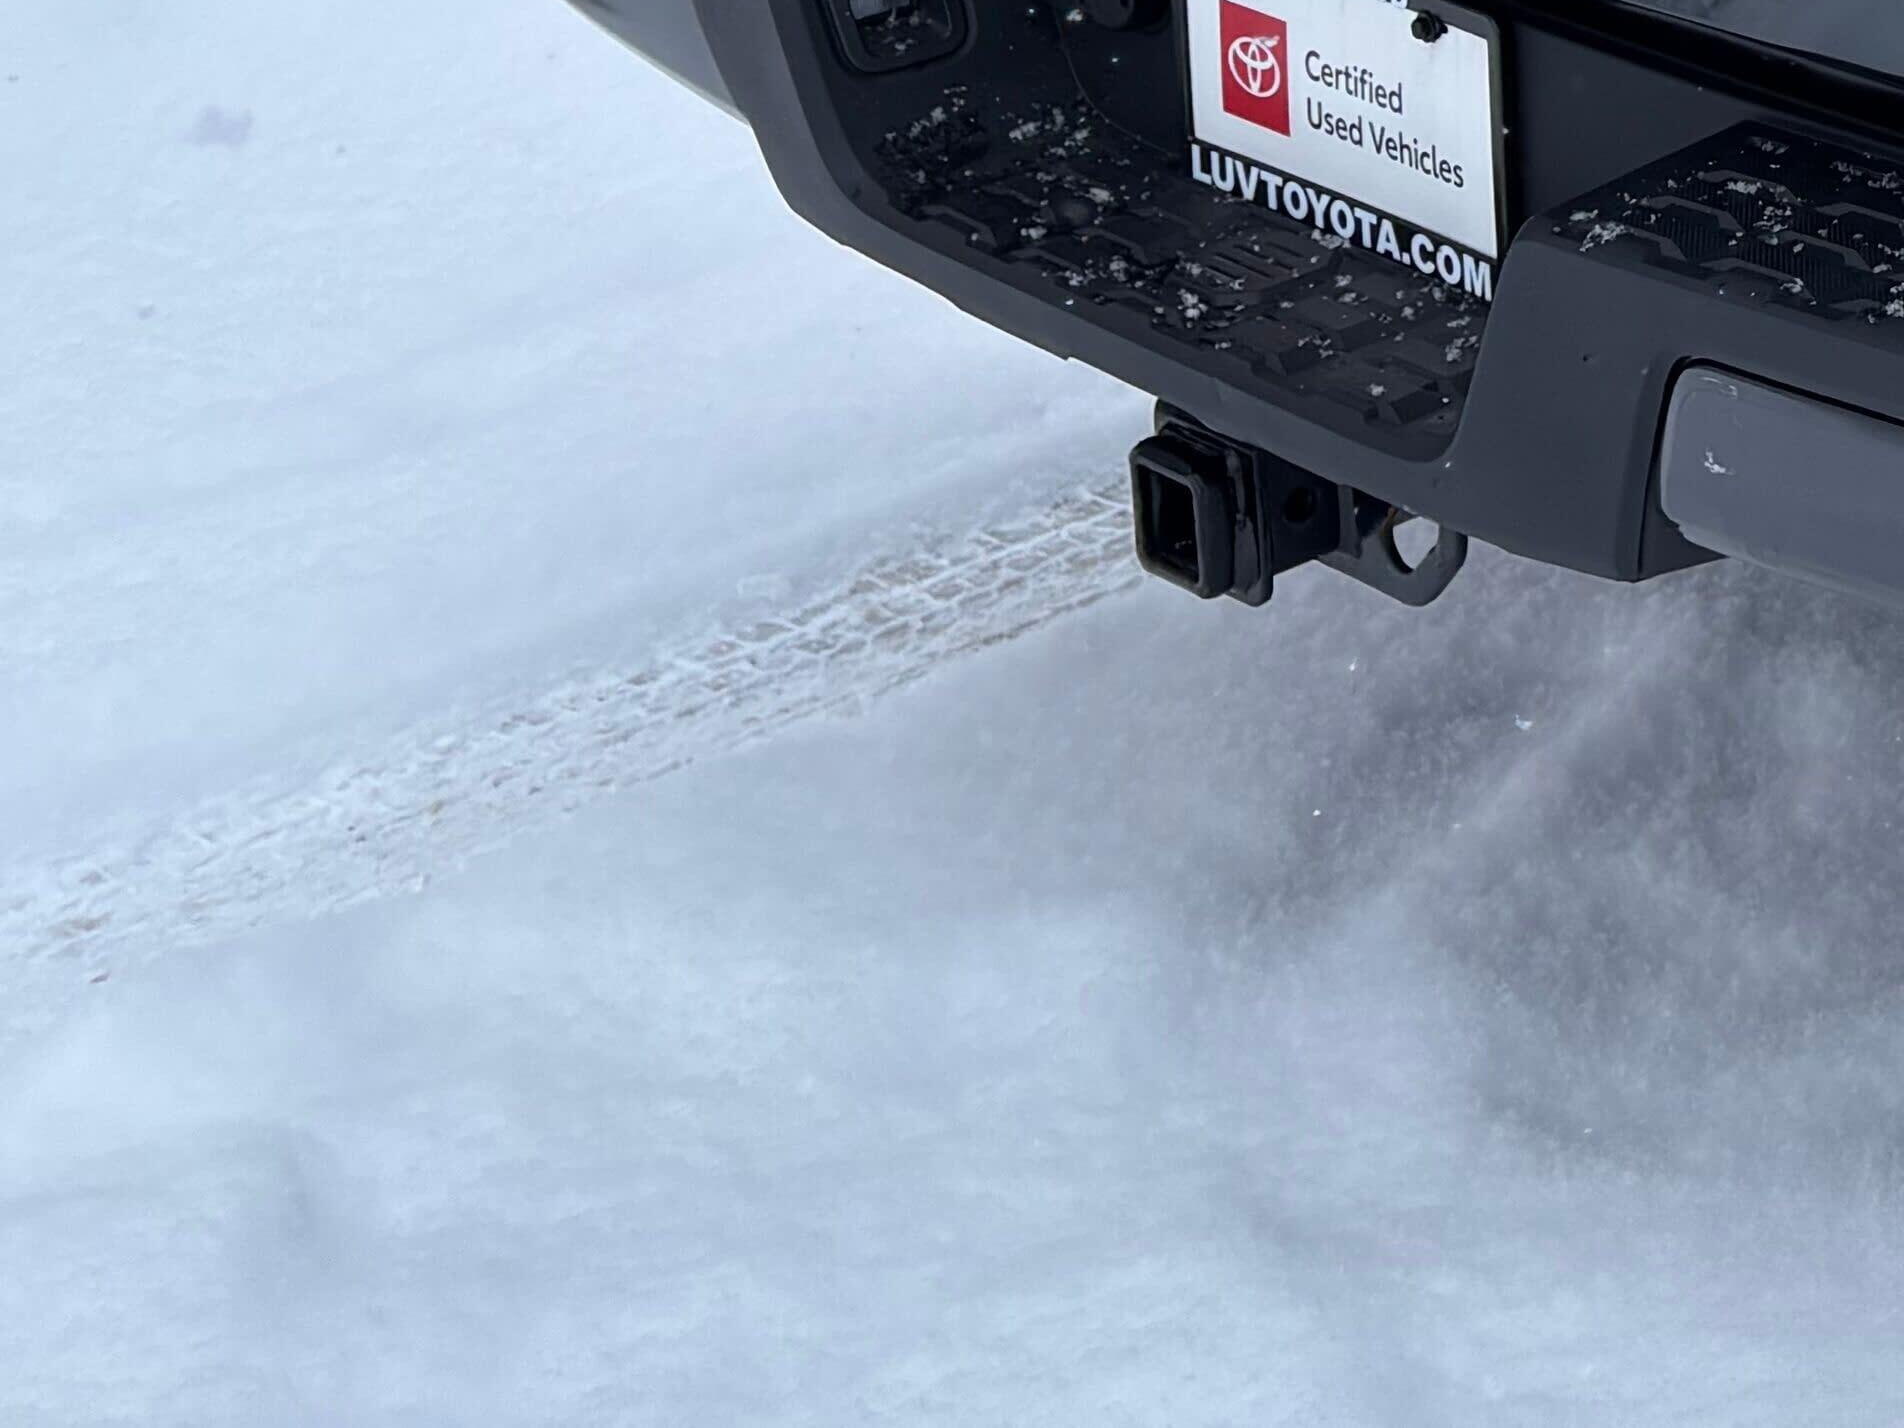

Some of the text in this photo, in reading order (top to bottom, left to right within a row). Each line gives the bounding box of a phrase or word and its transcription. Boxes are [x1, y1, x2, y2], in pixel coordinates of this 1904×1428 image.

[1304, 50, 1403, 115] Certified
[1306, 97, 1464, 189] Used Vehicles
[1192, 145, 1492, 302] LUVTOYOTA.COM
